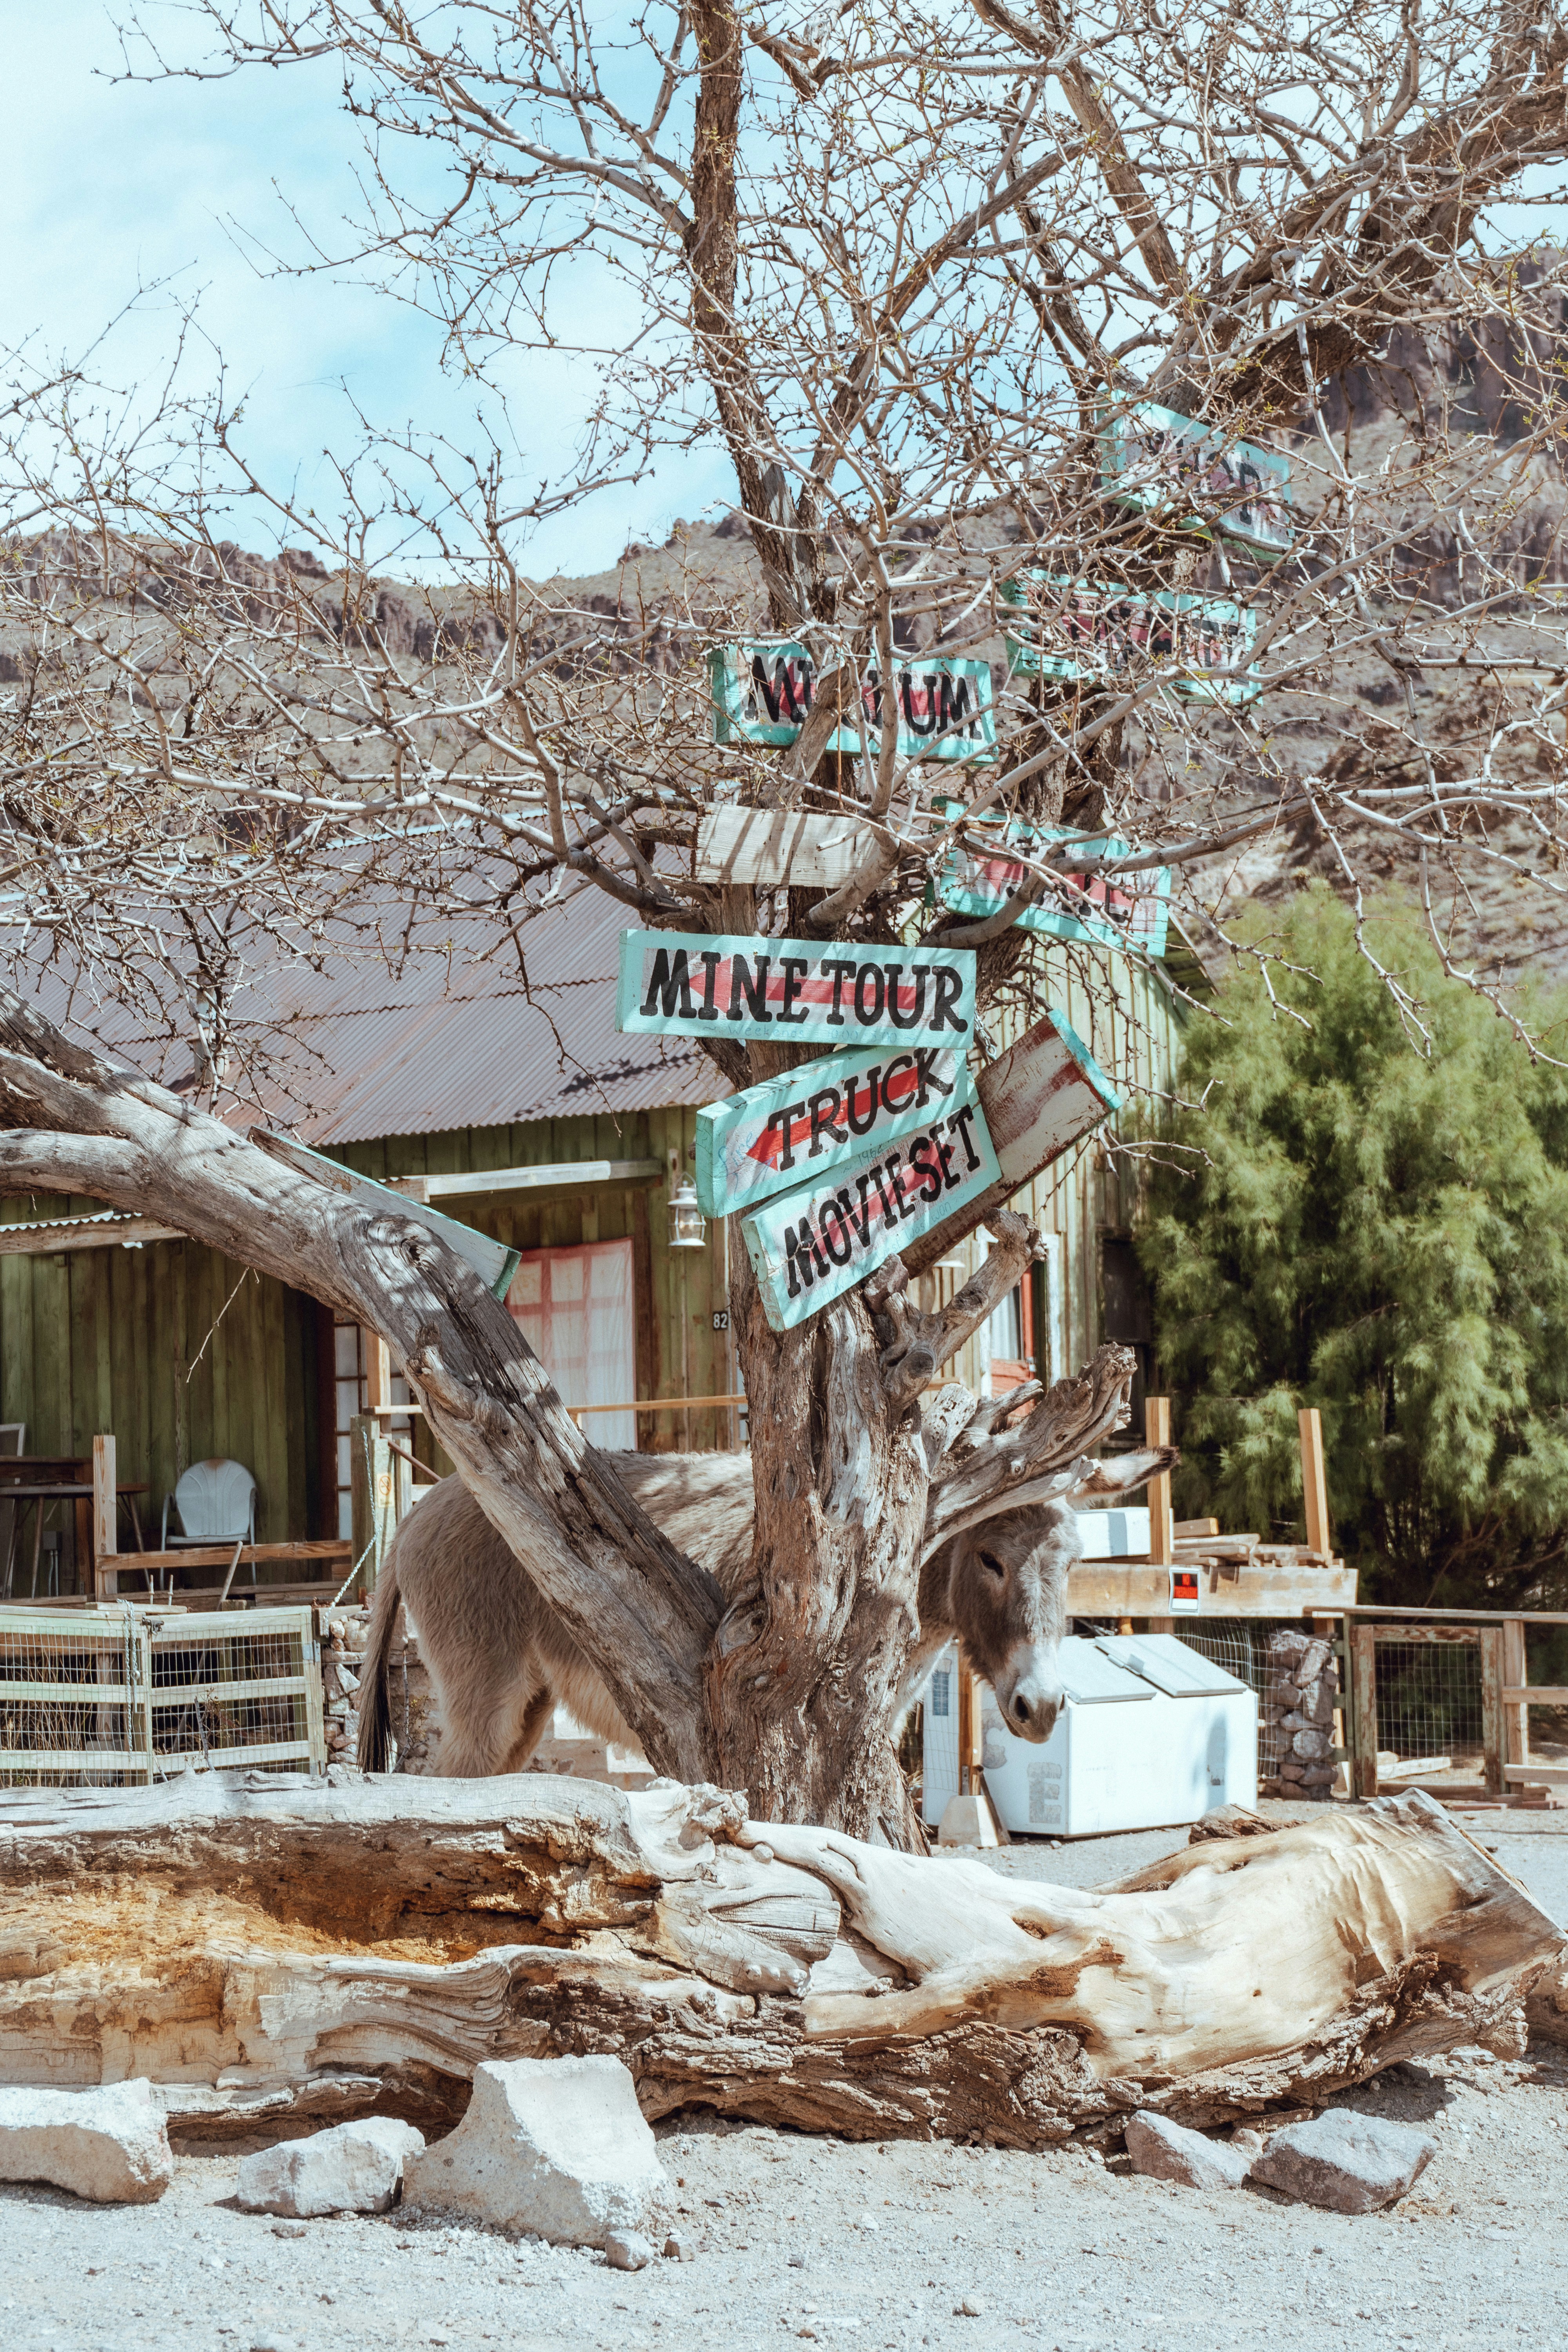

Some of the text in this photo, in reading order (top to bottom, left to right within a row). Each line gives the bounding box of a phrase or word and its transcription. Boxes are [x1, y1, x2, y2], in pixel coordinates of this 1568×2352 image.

[640, 948, 969, 1033] MINE TOUR
[768, 1047, 954, 1171] TRUCK
[784, 1104, 981, 1299] MOVIE SET
[713, 1313, 728, 1328] 82
